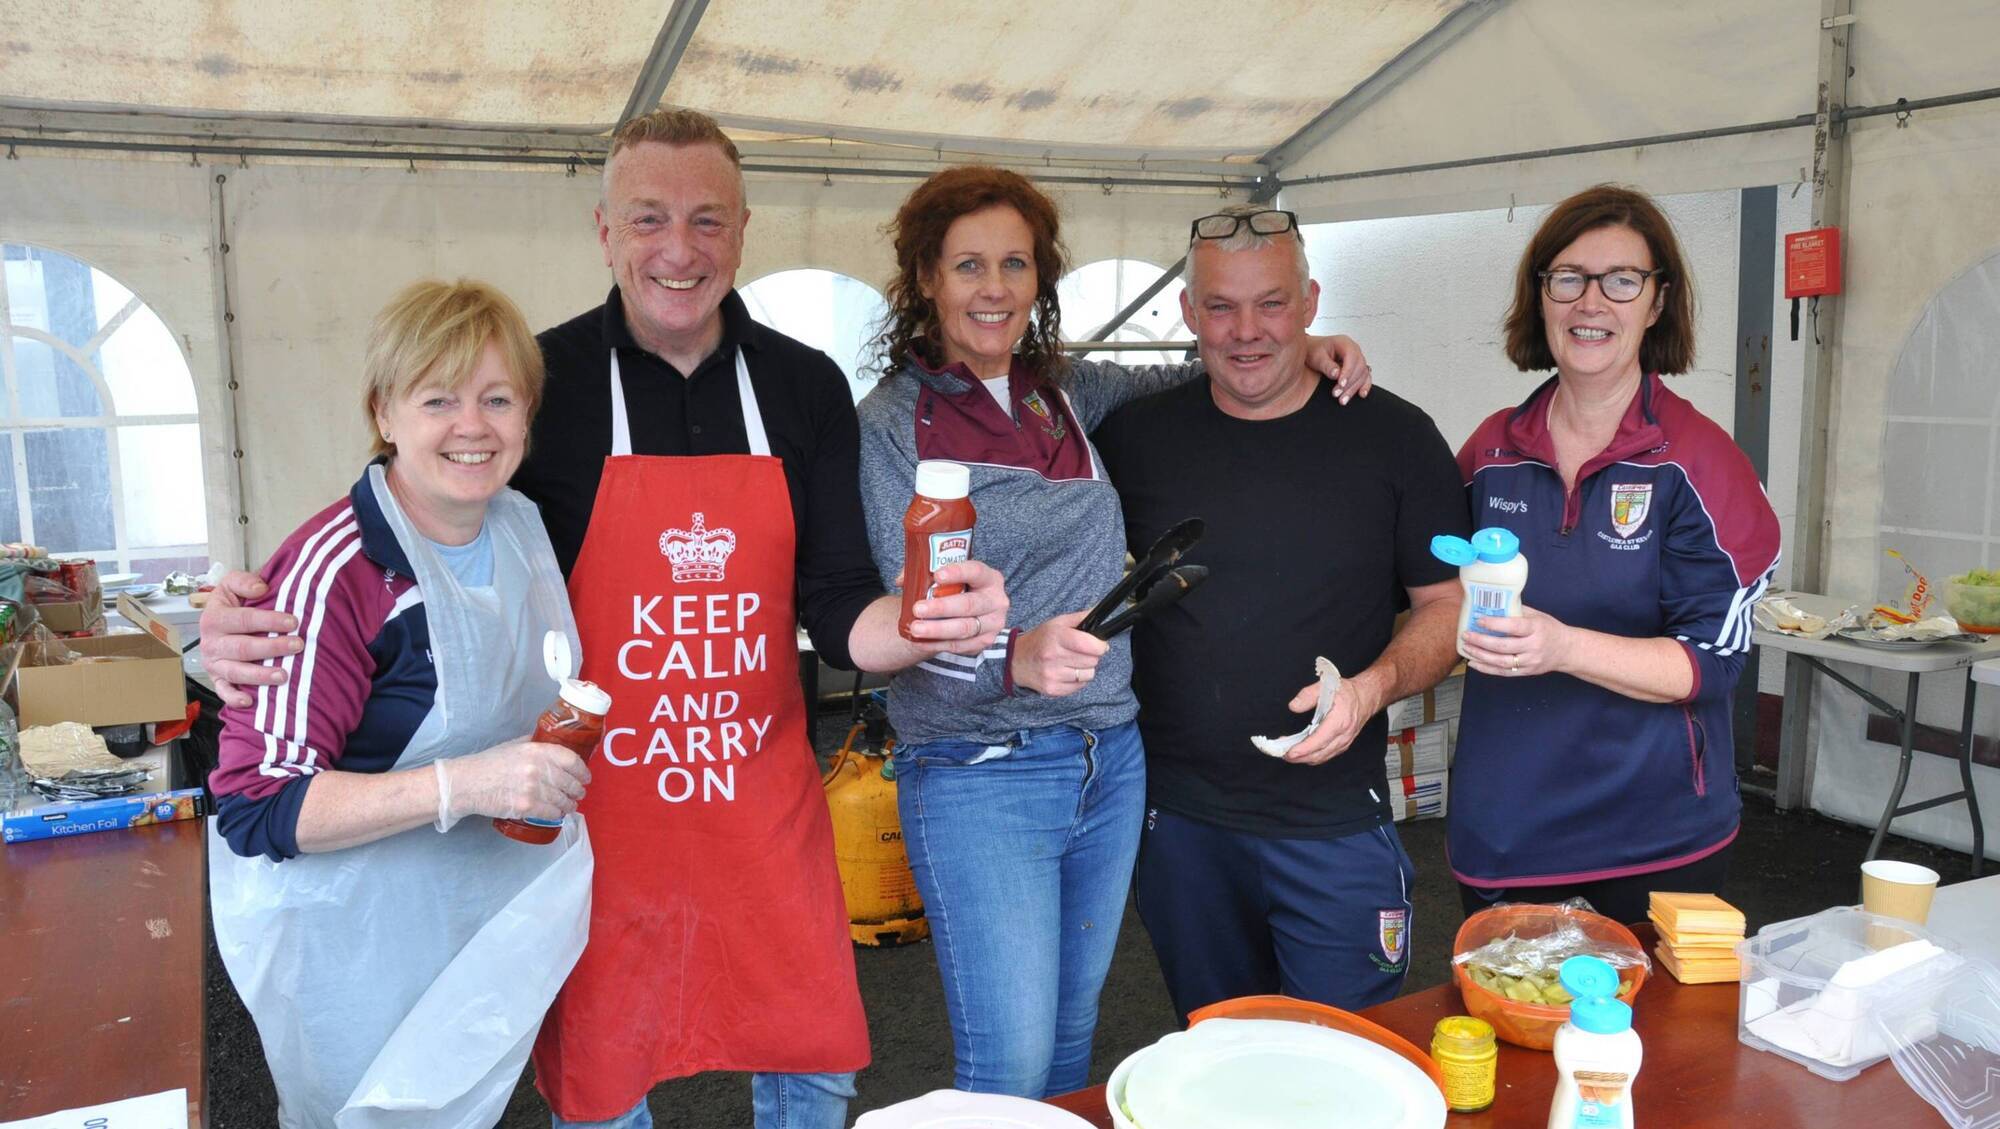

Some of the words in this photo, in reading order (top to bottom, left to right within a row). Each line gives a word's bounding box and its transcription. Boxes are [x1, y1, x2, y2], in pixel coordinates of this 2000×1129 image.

[1489, 496, 1528, 514] Wispy's
[632, 592, 760, 635] KEEP
[617, 634, 767, 681] CALM
[648, 690, 740, 724] AND
[603, 715, 772, 767] CARRY
[657, 764, 735, 804] ON
[52, 822, 96, 835] Kitchen
[98, 818, 118, 829] Foil
[158, 804, 171, 815] 50
